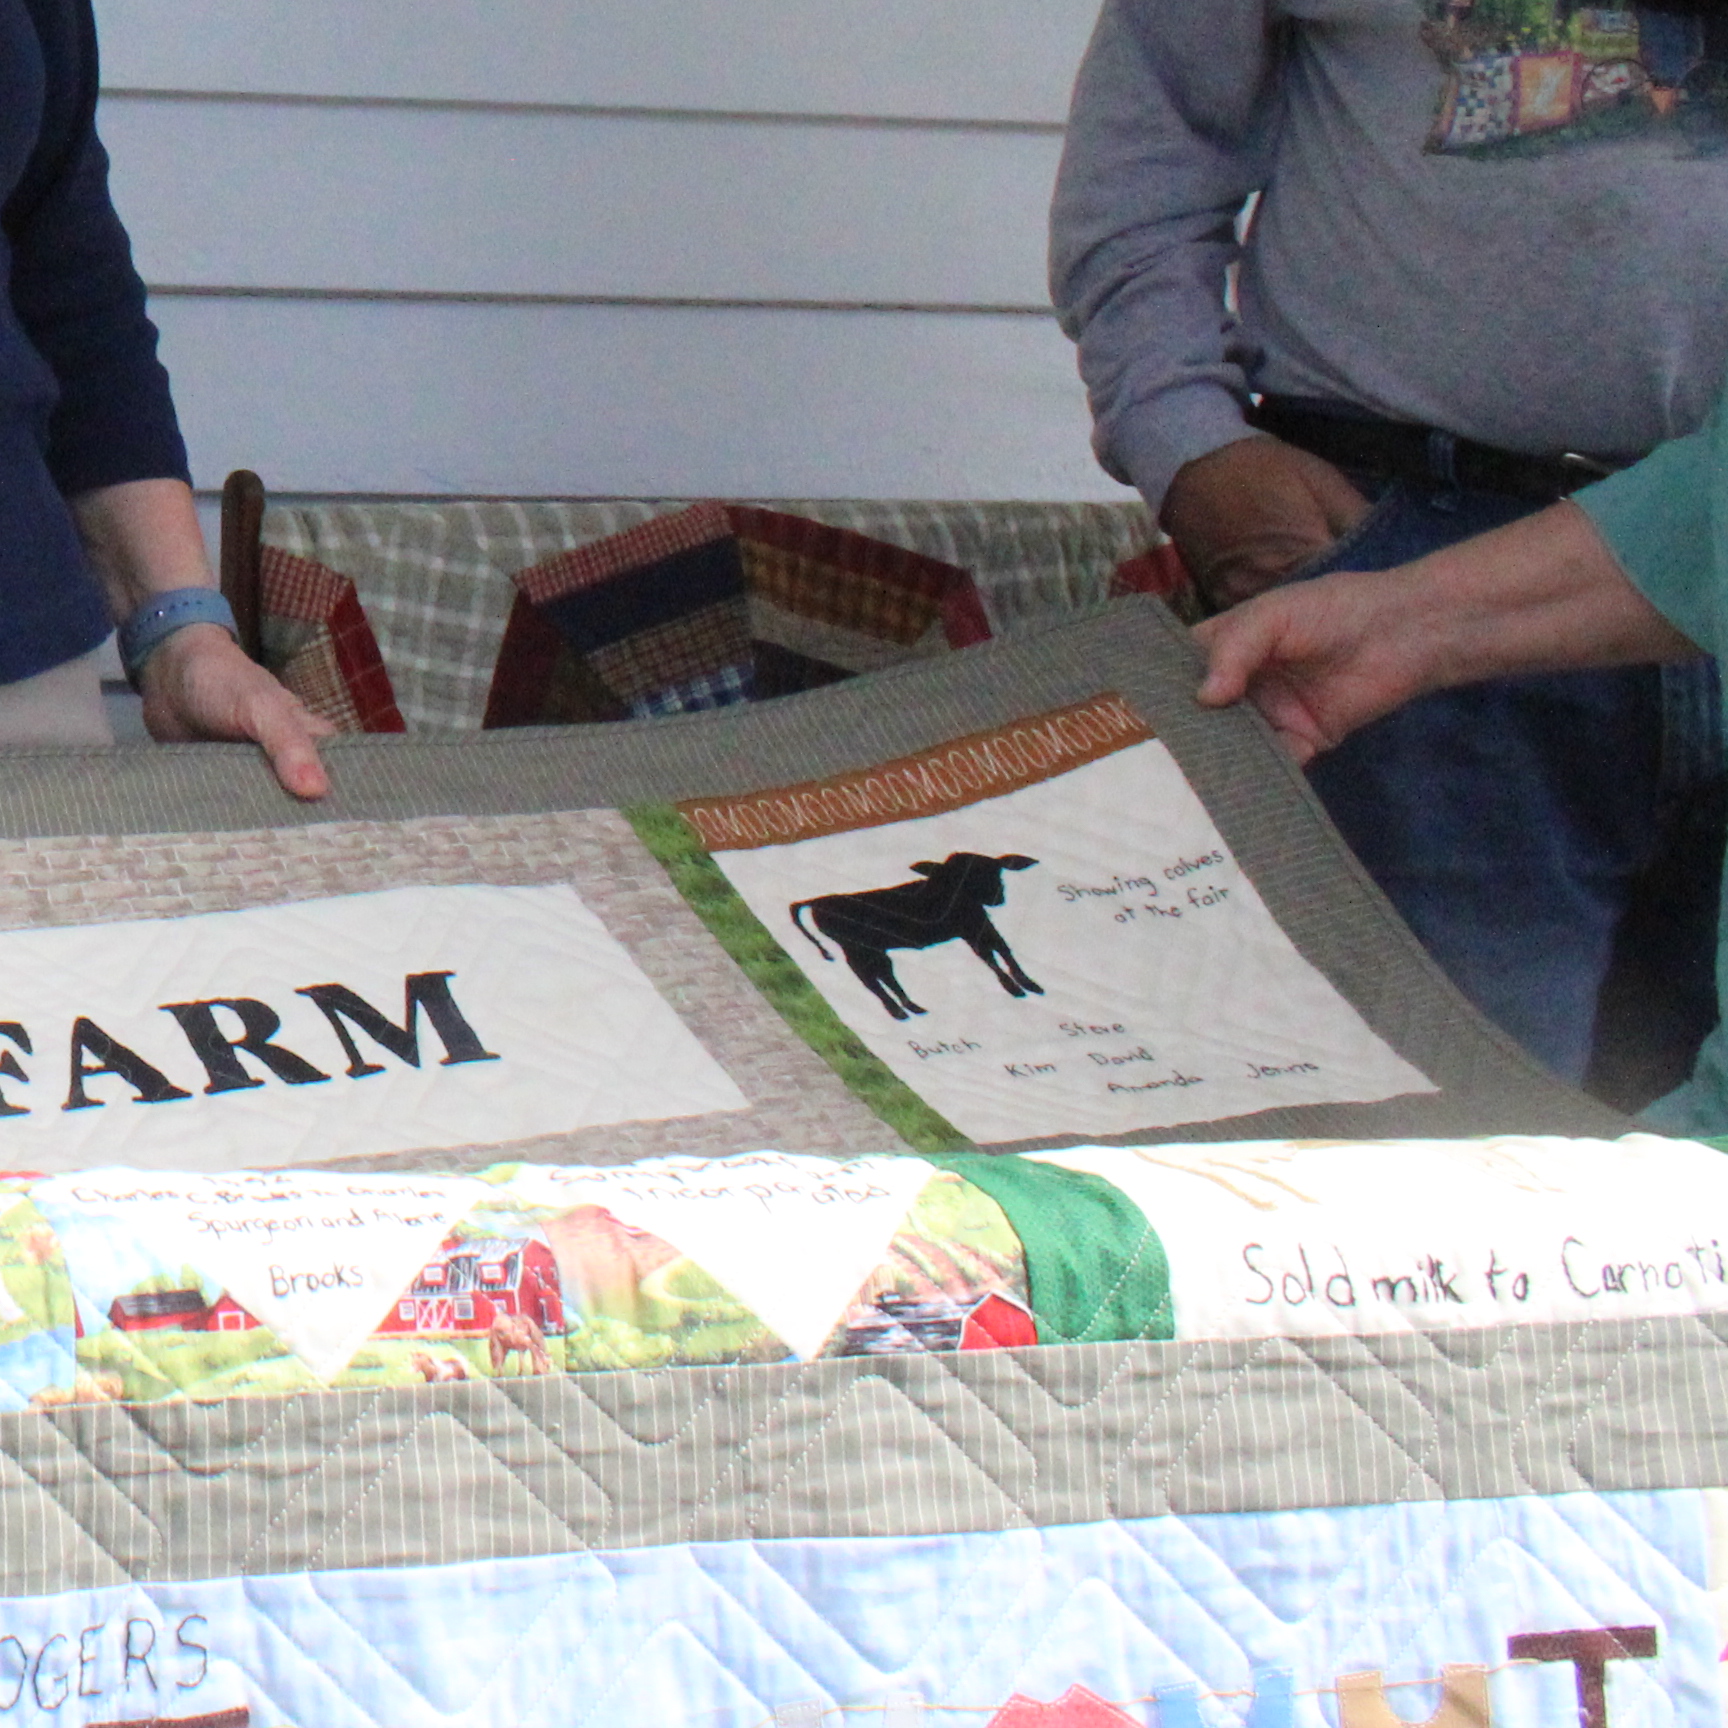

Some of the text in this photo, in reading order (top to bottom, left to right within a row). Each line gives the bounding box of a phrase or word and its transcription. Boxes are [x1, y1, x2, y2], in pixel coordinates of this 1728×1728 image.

[1057, 849, 1224, 903] Showing calves
[1114, 885, 1230, 923] at the fair
[1059, 1021, 1126, 1038] Steve
[906, 1037, 982, 1060] Butch
[1003, 1046, 1155, 1079] Kim David
[1106, 1070, 1204, 1094] Amanda
[269, 1262, 364, 1298] Brooks
[1242, 1242, 1356, 1308] Sold
[1371, 1252, 1465, 1304] milk
[1486, 1248, 1530, 1302] to
